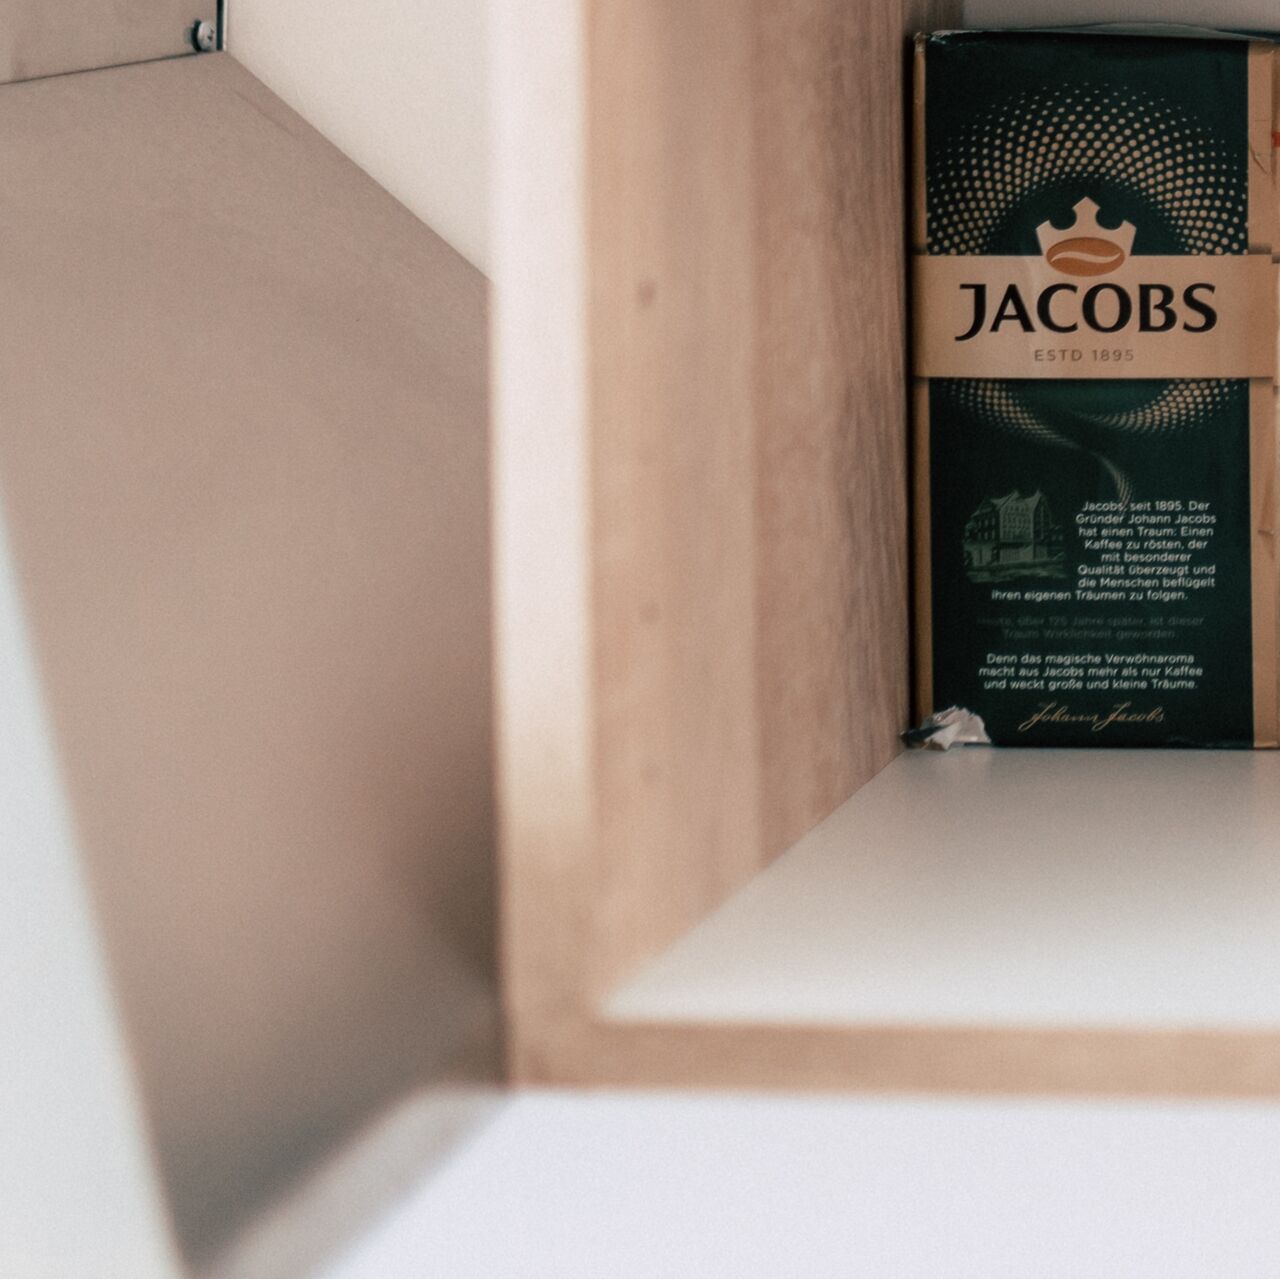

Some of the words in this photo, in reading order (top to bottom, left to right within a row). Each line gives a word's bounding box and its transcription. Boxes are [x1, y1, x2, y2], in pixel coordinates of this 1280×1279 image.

[954, 282, 1218, 342] JACOBS
[1034, 348, 1083, 362] ESTD
[1091, 348, 1134, 362] 1895
[1130, 501, 1152, 511] seit
[1155, 501, 1185, 511] 1895.
[1188, 501, 1211, 511] Der
[1076, 513, 1125, 524] Gründer
[1128, 513, 1171, 524] Johann
[1174, 513, 1217, 524] Jacobs
[1079, 526, 1098, 537] hat
[1101, 526, 1134, 537] einen
[1180, 526, 1214, 537] Einen
[1084, 539, 1123, 550] Kaffee
[1126, 540, 1140, 550] zu
[1143, 539, 1184, 551] rösten,
[1187, 539, 1208, 550] der
[1101, 552, 1120, 562] mit
[1124, 551, 1192, 562] besonderer
[1077, 564, 1125, 575] Qualität
[1128, 564, 1189, 577] überzeugt
[1192, 564, 1216, 575] und
[1078, 577, 1096, 588] die
[1100, 577, 1160, 588] Menschen
[1162, 577, 1216, 589] beflügelt
[1024, 590, 1071, 602] eigenen
[1075, 589, 1126, 600] Träumen
[1129, 591, 1144, 600] zu
[1147, 589, 1188, 602] folgen.
[986, 653, 1018, 664] Denn
[1020, 653, 1042, 664] das
[1045, 653, 1102, 666] magische
[1105, 652, 1195, 664] Verwöhnaroma
[978, 666, 1016, 677] macht
[1019, 667, 1040, 677] aus
[1042, 666, 1084, 677] Jacobs
[1087, 666, 1119, 677] mehr
[1121, 666, 1139, 677] als
[1141, 667, 1162, 677] nur
[1165, 666, 1204, 677] Kaffee
[983, 679, 1007, 690] und
[1009, 679, 1045, 690] weckt
[1048, 679, 1084, 692] große
[1086, 679, 1110, 690] und
[1112, 679, 1148, 690] kleine
[1151, 679, 1198, 690] Träume.
